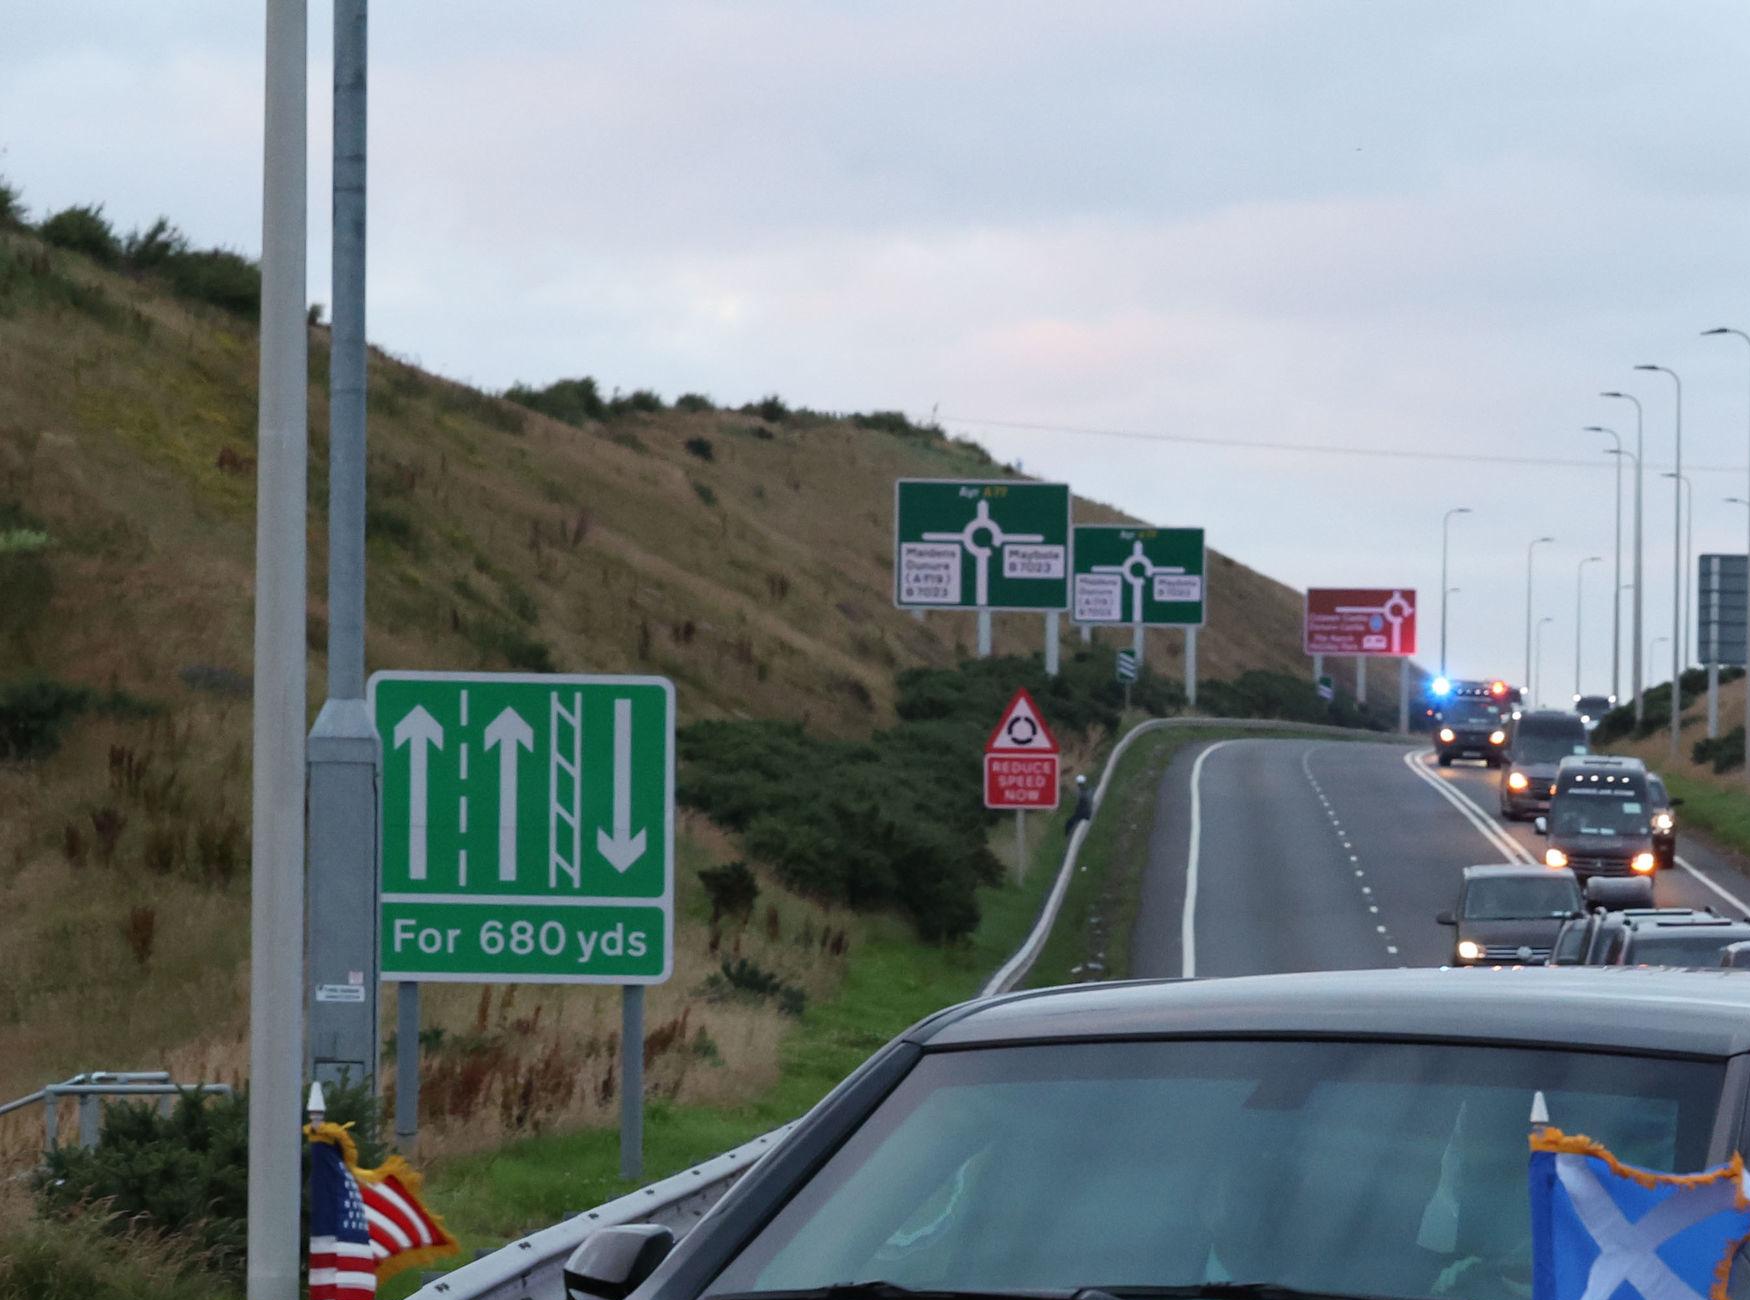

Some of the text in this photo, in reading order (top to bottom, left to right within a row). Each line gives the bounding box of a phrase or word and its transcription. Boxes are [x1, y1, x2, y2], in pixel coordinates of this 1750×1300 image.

[992, 761, 1051, 774] REDUCE
[998, 775, 1046, 788] SPEED
[1004, 789, 1040, 801] NOW
[393, 918, 647, 963] For 680 yds
